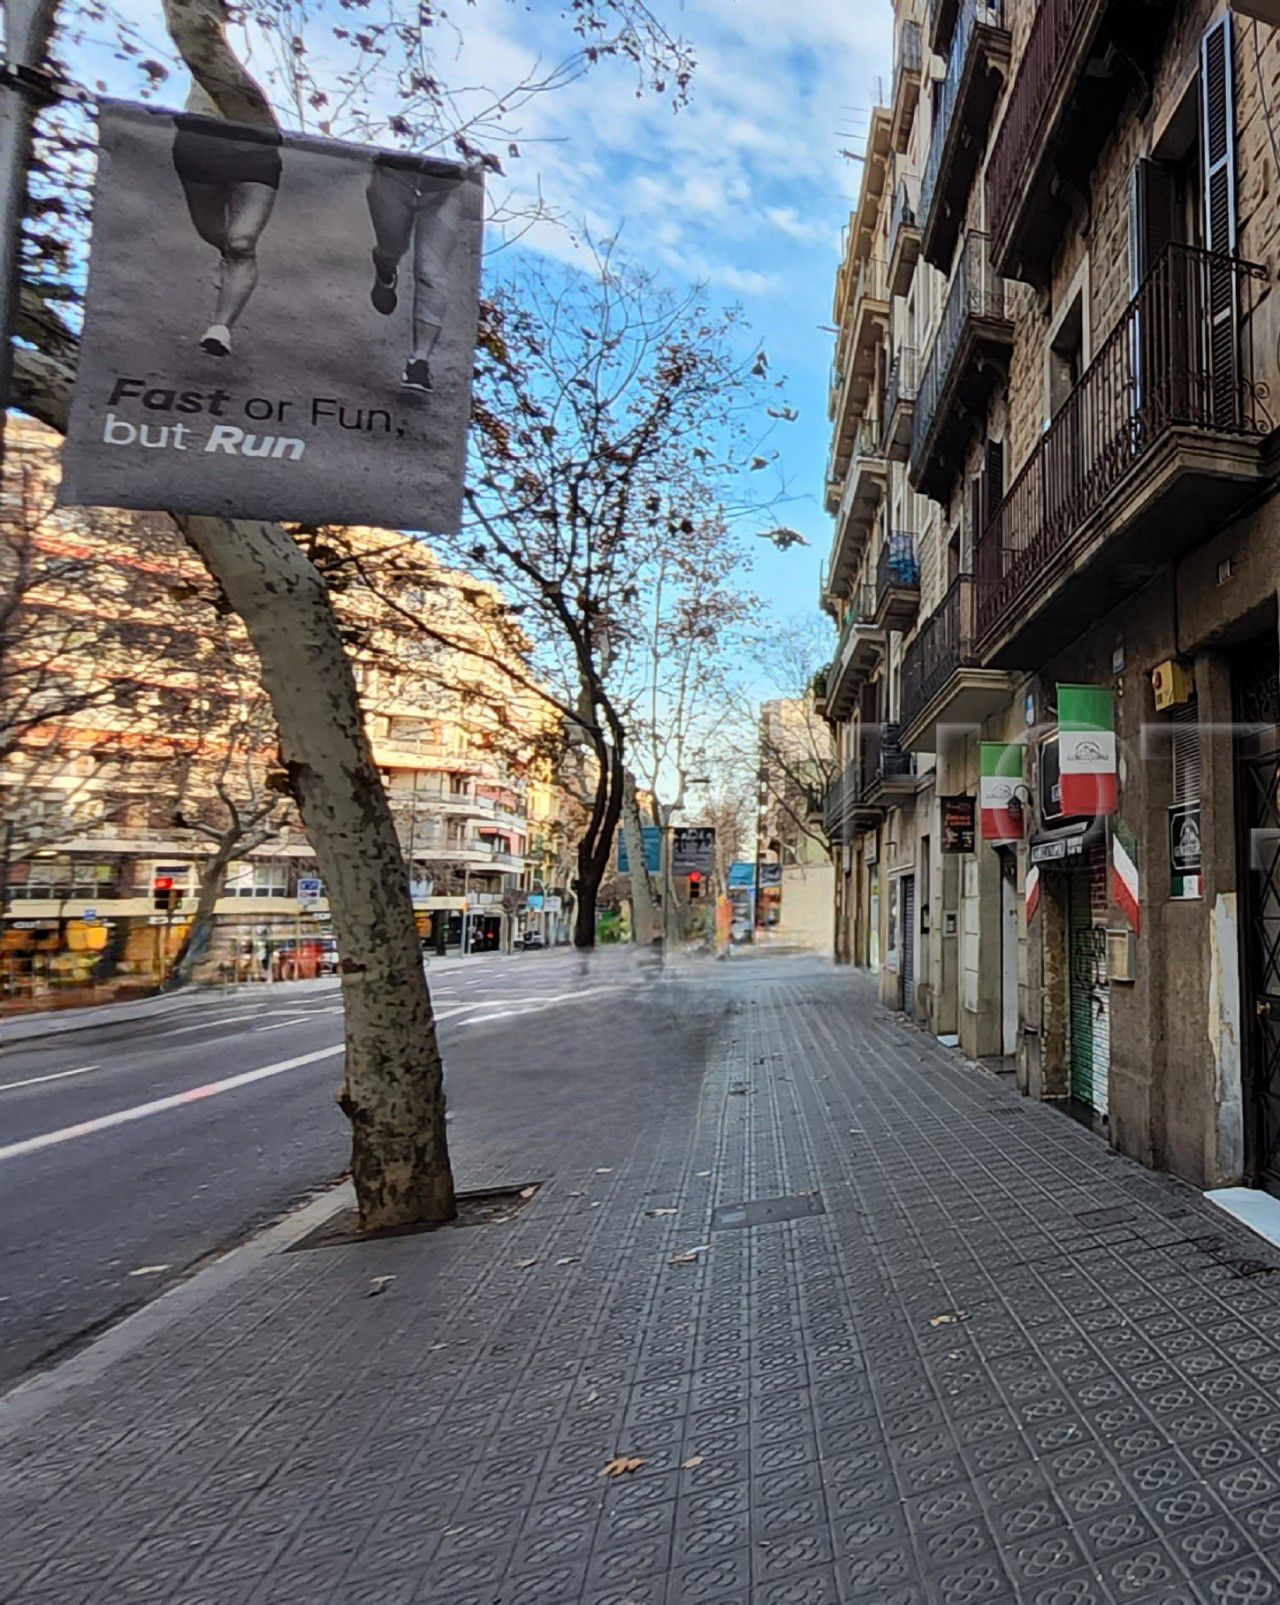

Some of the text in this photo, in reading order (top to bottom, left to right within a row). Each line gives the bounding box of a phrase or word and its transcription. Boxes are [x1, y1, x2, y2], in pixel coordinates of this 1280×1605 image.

[107, 377, 405, 439] Fast or Fun,
[103, 413, 306, 460] but Run
